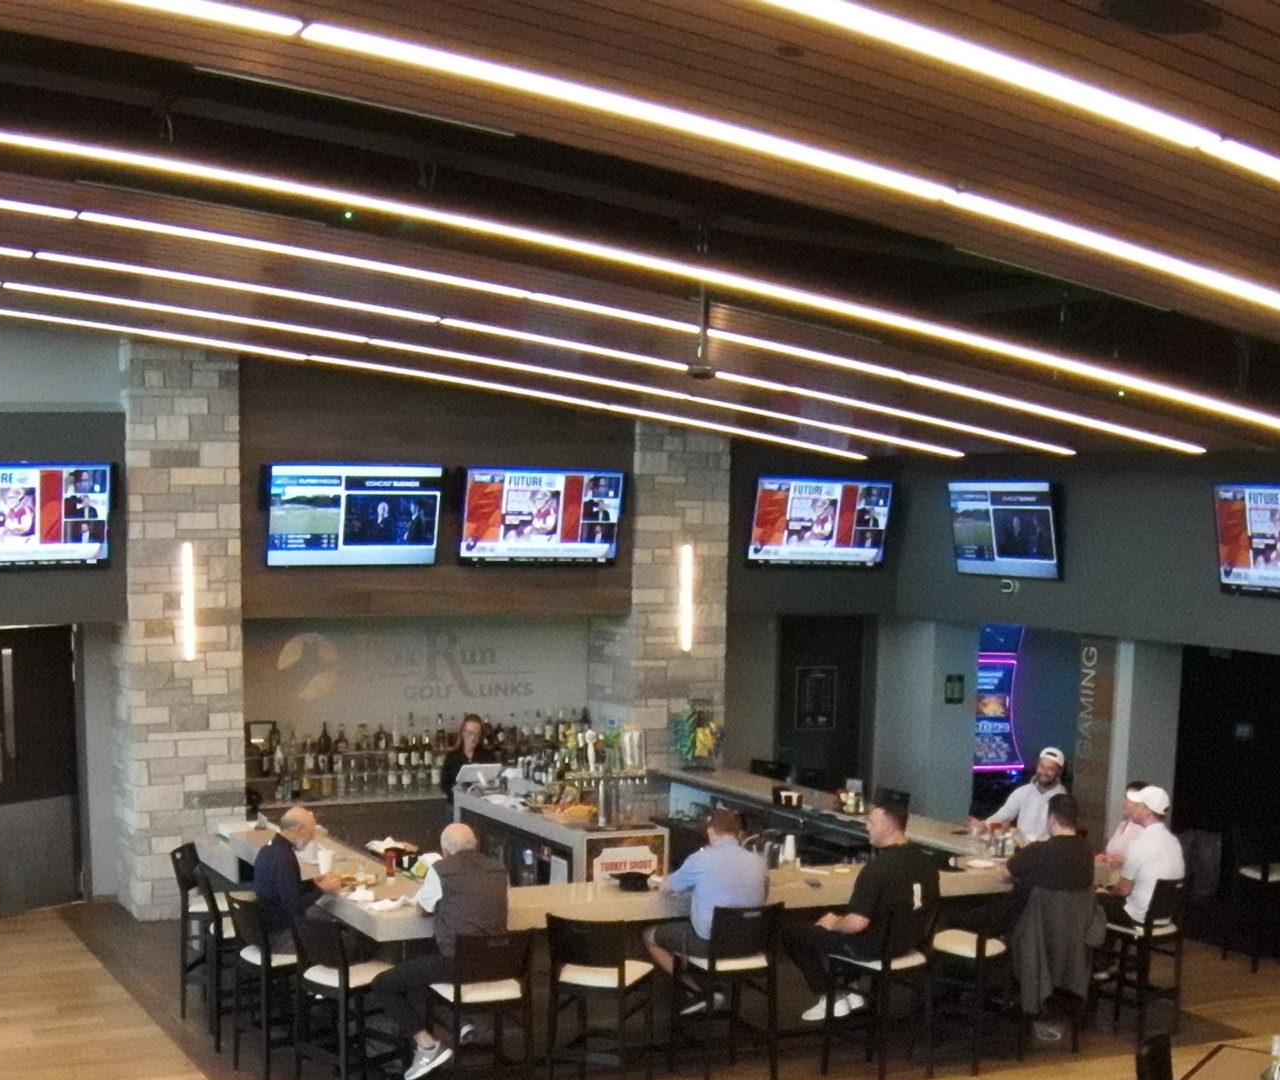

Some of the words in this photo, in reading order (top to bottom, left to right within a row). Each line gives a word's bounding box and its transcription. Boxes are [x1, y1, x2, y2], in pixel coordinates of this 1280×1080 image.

[508, 476, 543, 487] FUTURE
[404, 685, 454, 700] GOLF
[479, 682, 534, 697] LINKS
[1077, 646, 1098, 758] GAMING
